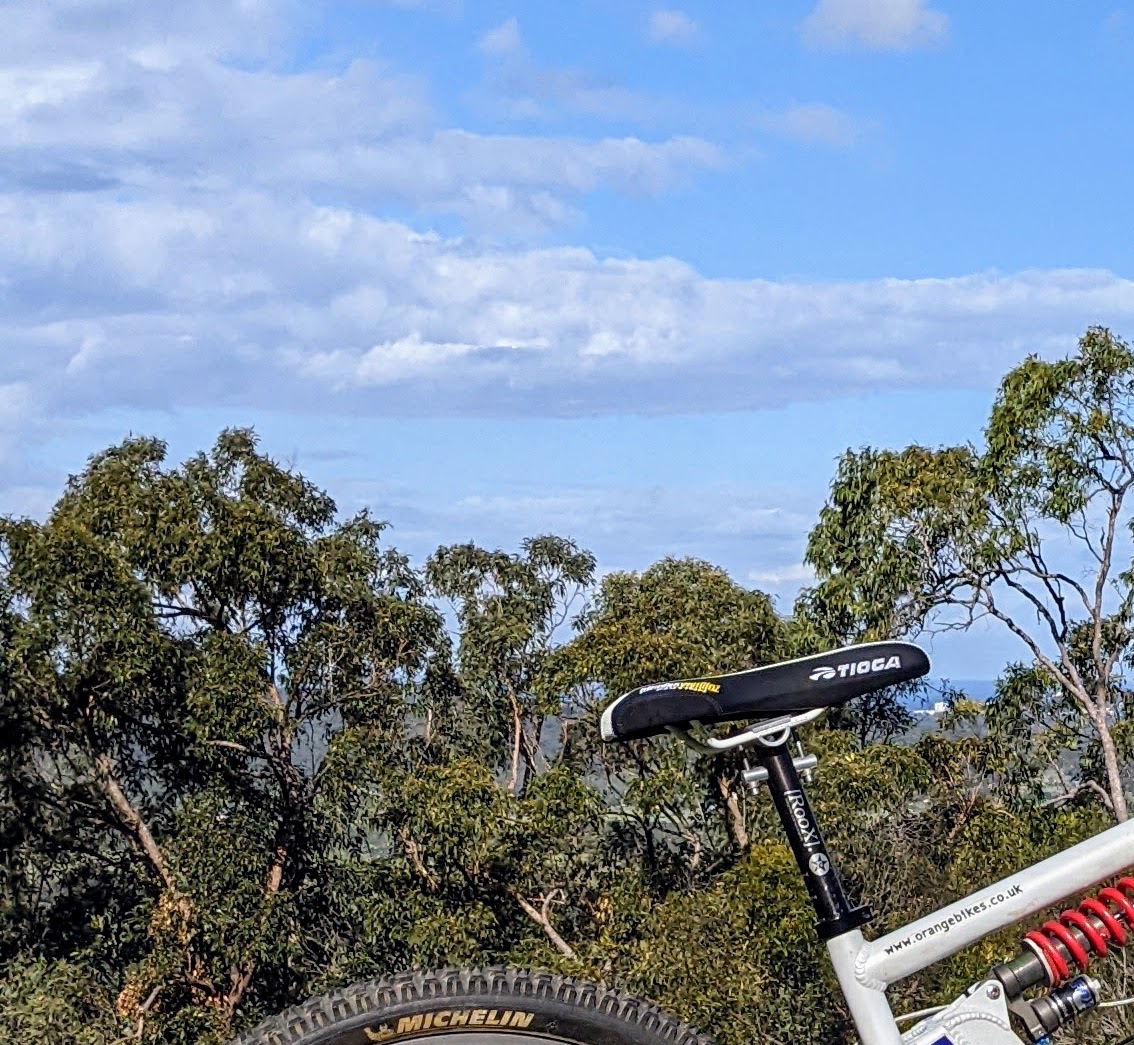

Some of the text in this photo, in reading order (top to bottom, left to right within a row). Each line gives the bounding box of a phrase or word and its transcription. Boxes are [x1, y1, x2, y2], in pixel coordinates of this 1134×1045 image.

[837, 655, 902, 678] TIOGA
[883, 882, 1024, 956] www.orangebikes.co.uk
[396, 1009, 535, 1034] MICHELIN
